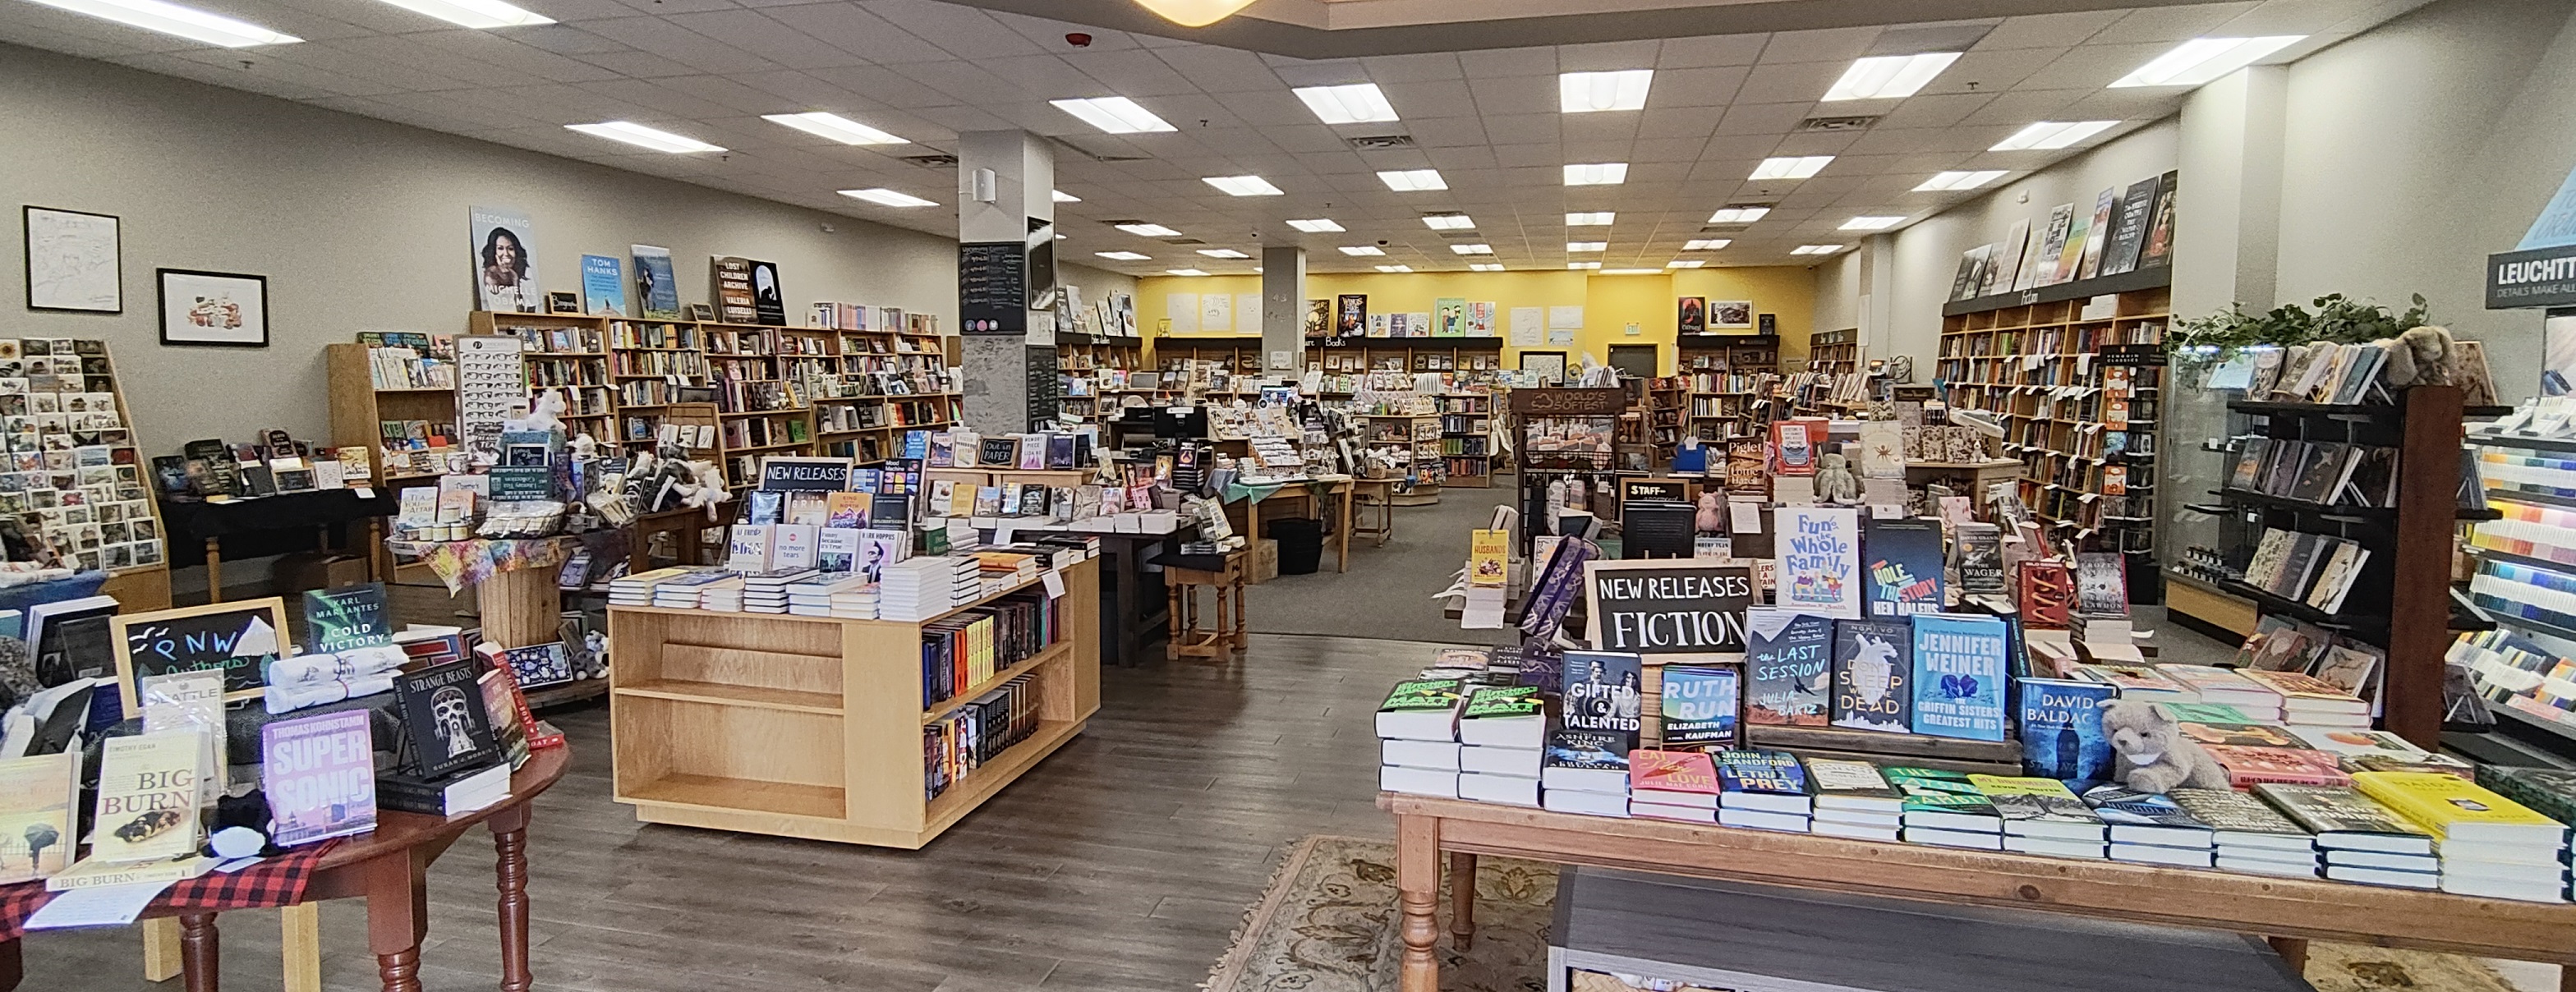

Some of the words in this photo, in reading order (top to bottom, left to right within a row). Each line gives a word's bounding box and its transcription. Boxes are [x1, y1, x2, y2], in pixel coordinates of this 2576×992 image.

[475, 213, 530, 228] BECOMING
[591, 258, 611, 268] TOM
[724, 262, 741, 270] LOST
[587, 266, 619, 276] HANKS
[720, 271, 748, 280] CHILDREN
[485, 284, 536, 296] MICHELLE
[724, 281, 749, 290] ARCHIVE
[2497, 287, 2529, 298] DETAILS
[2532, 284, 2558, 295] MAKE
[493, 295, 532, 308] OBAMA
[725, 296, 750, 305] VALERIA
[727, 306, 752, 315] LUISELLI
[1325, 337, 1346, 347] Books
[1554, 392, 1608, 401] WORLD'S
[1554, 401, 1608, 410] SOFTEST
[1728, 442, 1763, 454] Piglet
[984, 451, 1010, 461] PAPER
[767, 466, 791, 480] NEW
[794, 466, 847, 480] RELEASES
[1731, 467, 1758, 476] Lottie
[1731, 475, 1759, 485] Hazell
[792, 499, 824, 508] GRID
[1798, 514, 1833, 535] Fun
[1829, 516, 1839, 530] for
[1816, 532, 1832, 541] the
[1474, 545, 1506, 554] HUSBANDS
[1790, 535, 1848, 553] Whole
[1786, 553, 1851, 580] Family
[1964, 568, 2003, 576] WAGER
[1874, 563, 1905, 586] HOLE
[1600, 577, 1644, 599] NEW
[1649, 576, 1750, 599] RELEASES
[1899, 577, 1938, 603] STORY
[333, 595, 361, 609] KARL
[1874, 601, 1894, 615] KEN
[315, 602, 380, 619] MARLANTES
[330, 623, 371, 638] COLD
[1612, 611, 1746, 649] FICTION
[154, 631, 237, 660] PNW
[320, 633, 386, 654] VICTORY
[1919, 633, 2003, 656] JENNIFER
[1777, 645, 1822, 663] LAST
[1756, 659, 1825, 681] SESSION
[1925, 652, 1994, 676] WEINER
[410, 673, 446, 694] STRANGE
[448, 666, 472, 685] BEASTS
[1840, 671, 1903, 690] SLEEP
[1571, 682, 1635, 699] GIFTED
[1664, 679, 1735, 699] RUTH
[1760, 689, 1796, 705] JULIA
[2042, 694, 2094, 710] DAVID
[1597, 702, 1607, 713] &
[1680, 700, 1734, 719] RUN
[1778, 704, 1818, 716] BARTZ
[1841, 695, 1900, 714] DEAD
[1917, 701, 1957, 715] GRIFFIN
[519, 706, 532, 724] BOAT
[1923, 714, 1971, 728] GREATEST
[1974, 719, 1997, 730] HITS
[2027, 708, 2092, 724] BALDAC
[273, 723, 310, 740] THOMAS
[310, 714, 365, 734] KOHNSTAMM
[1563, 714, 1640, 731] TALENTED
[1667, 721, 1721, 731] ELIZABETH
[1556, 733, 1615, 742] ASHFIRE
[1685, 730, 1732, 740] KAUFMAN
[528, 738, 548, 747] OAT
[273, 729, 368, 776] SUPER
[433, 759, 458, 771] SUSAN
[467, 748, 493, 760] MORRIS
[1639, 751, 1666, 760] EAT
[1723, 759, 1795, 767] SANDFORD
[1668, 774, 1711, 784] LOVE
[1727, 769, 1791, 779] LETHAL
[1892, 768, 1934, 776] THE
[137, 769, 196, 792] BIG
[1740, 778, 1801, 790] PREY
[275, 766, 370, 816] SONIC
[101, 790, 195, 815] BURN
[60, 875, 90, 889] BIG
[93, 872, 137, 886] BURN
